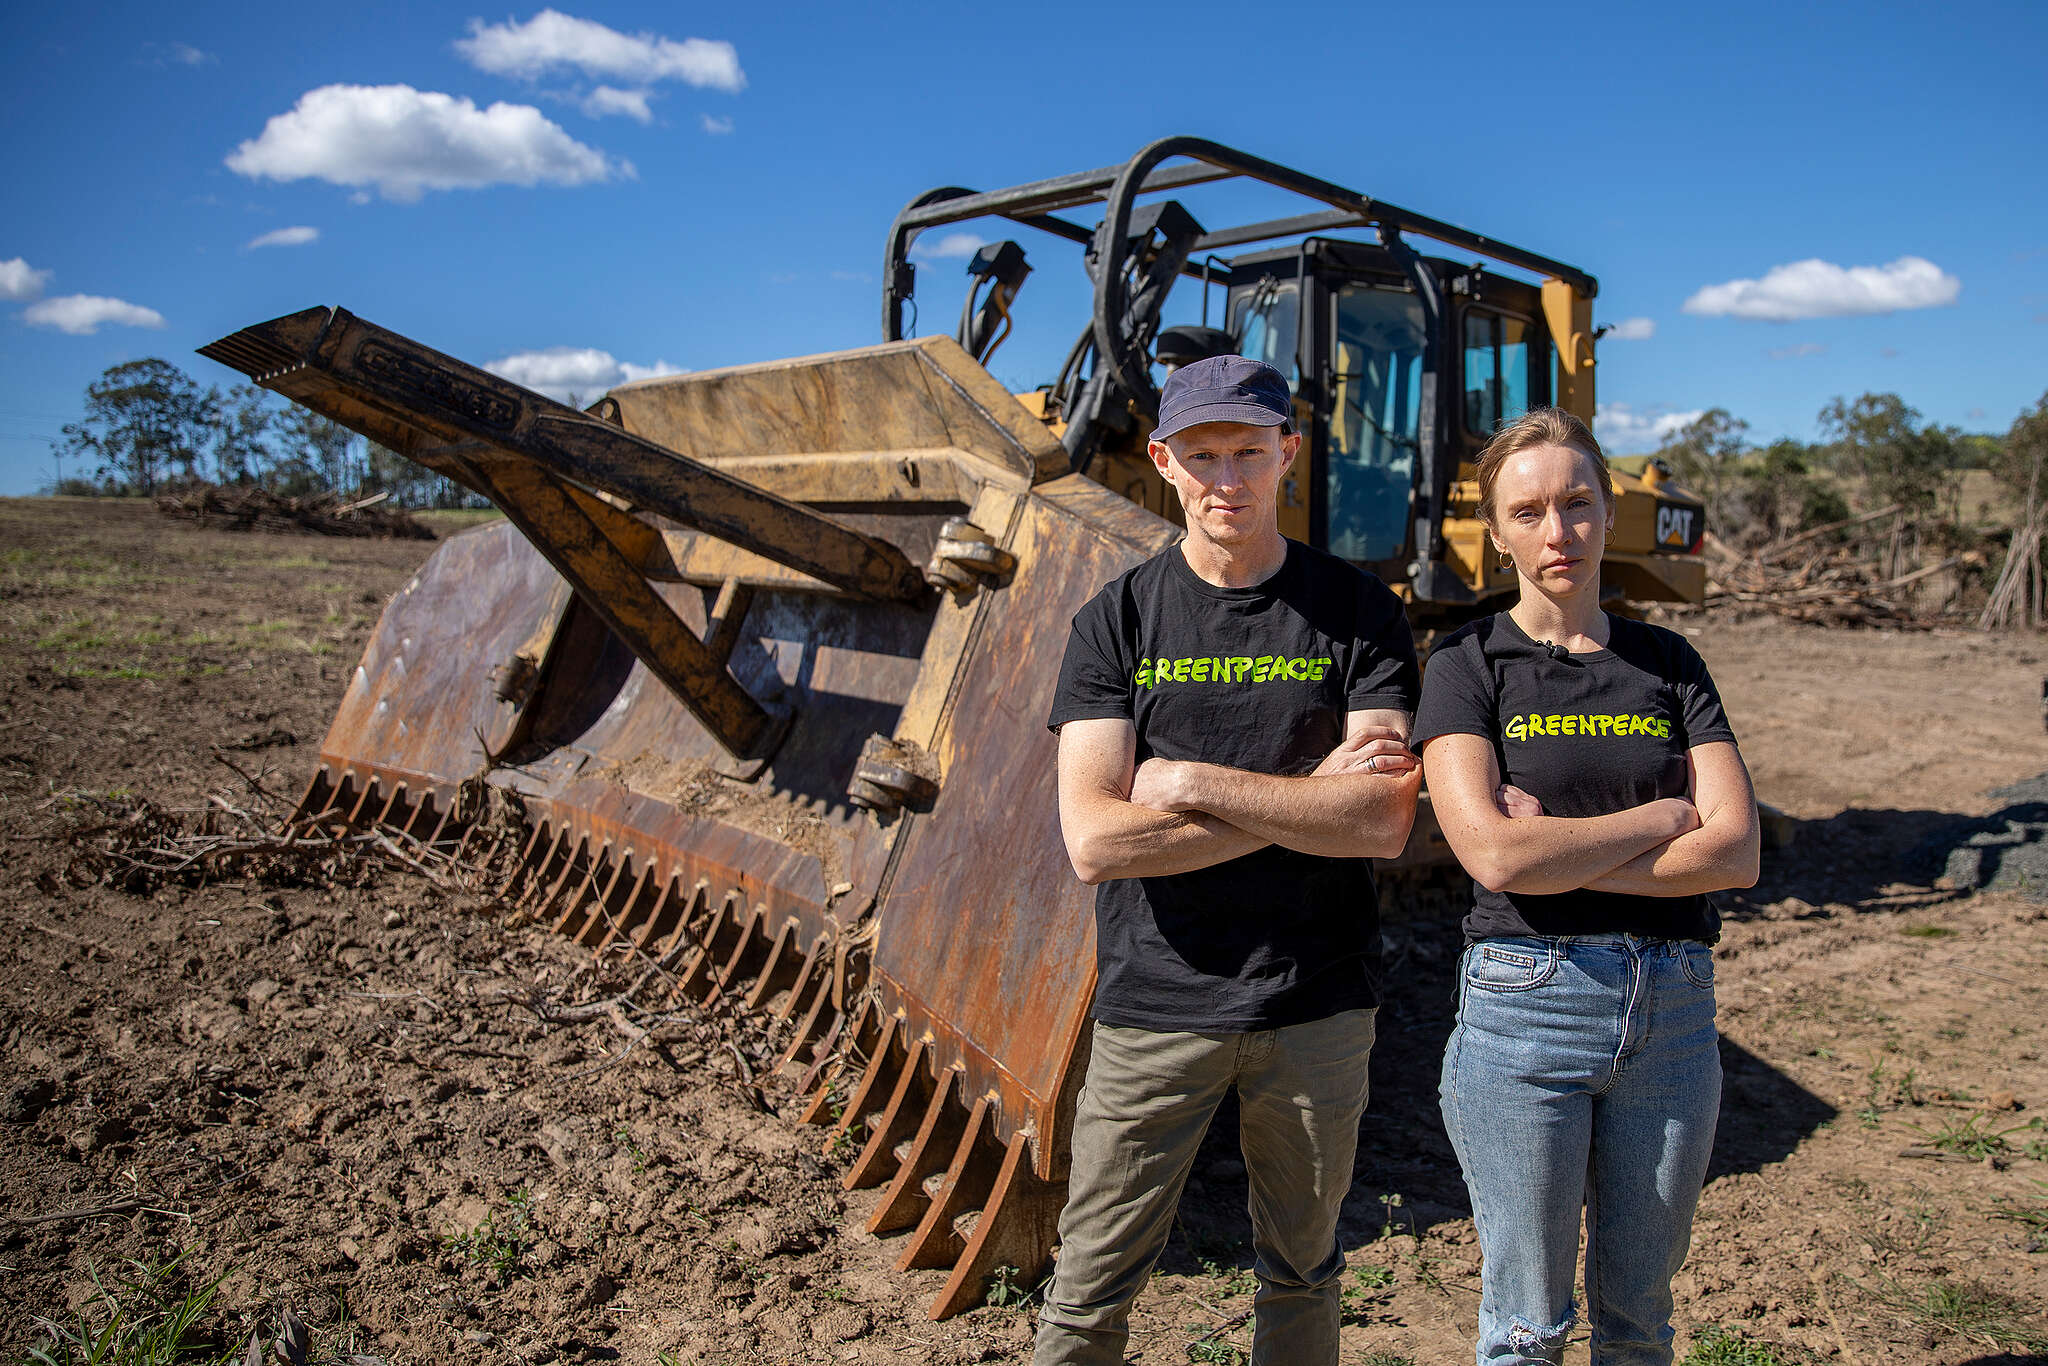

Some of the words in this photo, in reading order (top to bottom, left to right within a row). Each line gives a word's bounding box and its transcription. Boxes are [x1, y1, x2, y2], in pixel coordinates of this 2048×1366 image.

[1658, 506, 1693, 546] CAT
[1135, 655, 1332, 690] GREENPEACE
[1505, 713, 1671, 742] GREENPEACE
